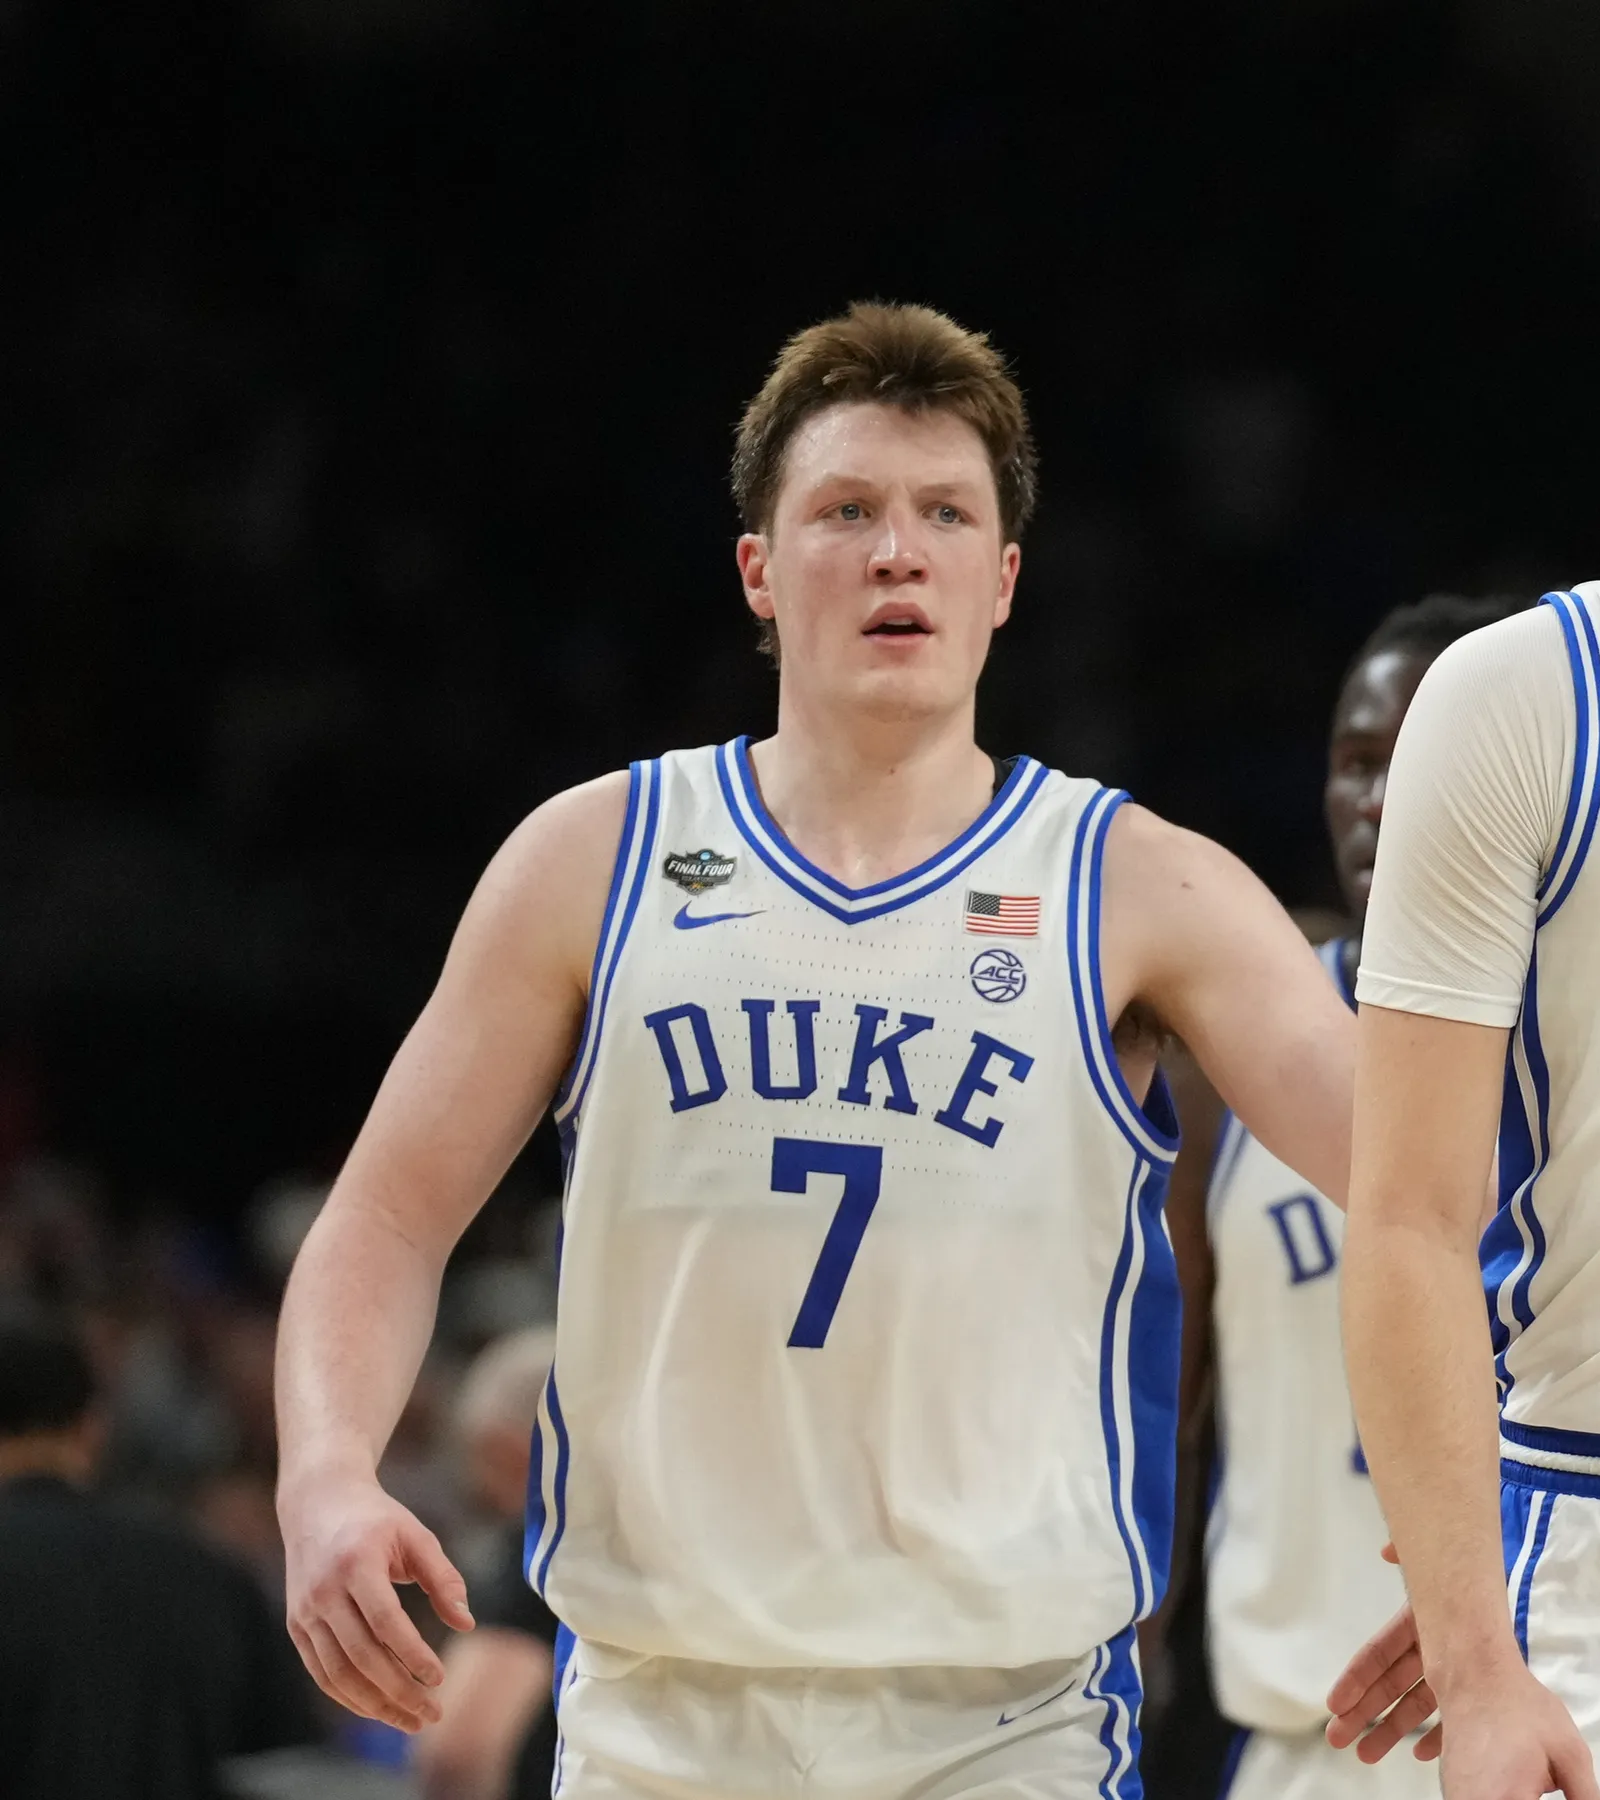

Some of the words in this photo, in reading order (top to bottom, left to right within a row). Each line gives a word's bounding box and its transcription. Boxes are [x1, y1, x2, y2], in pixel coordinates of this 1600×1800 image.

[668, 860, 702, 876] FINAL
[702, 863, 734, 877] FOUR
[977, 965, 1023, 982] ACC
[645, 999, 1034, 1148] DUKE
[770, 1136, 882, 1348] 7
